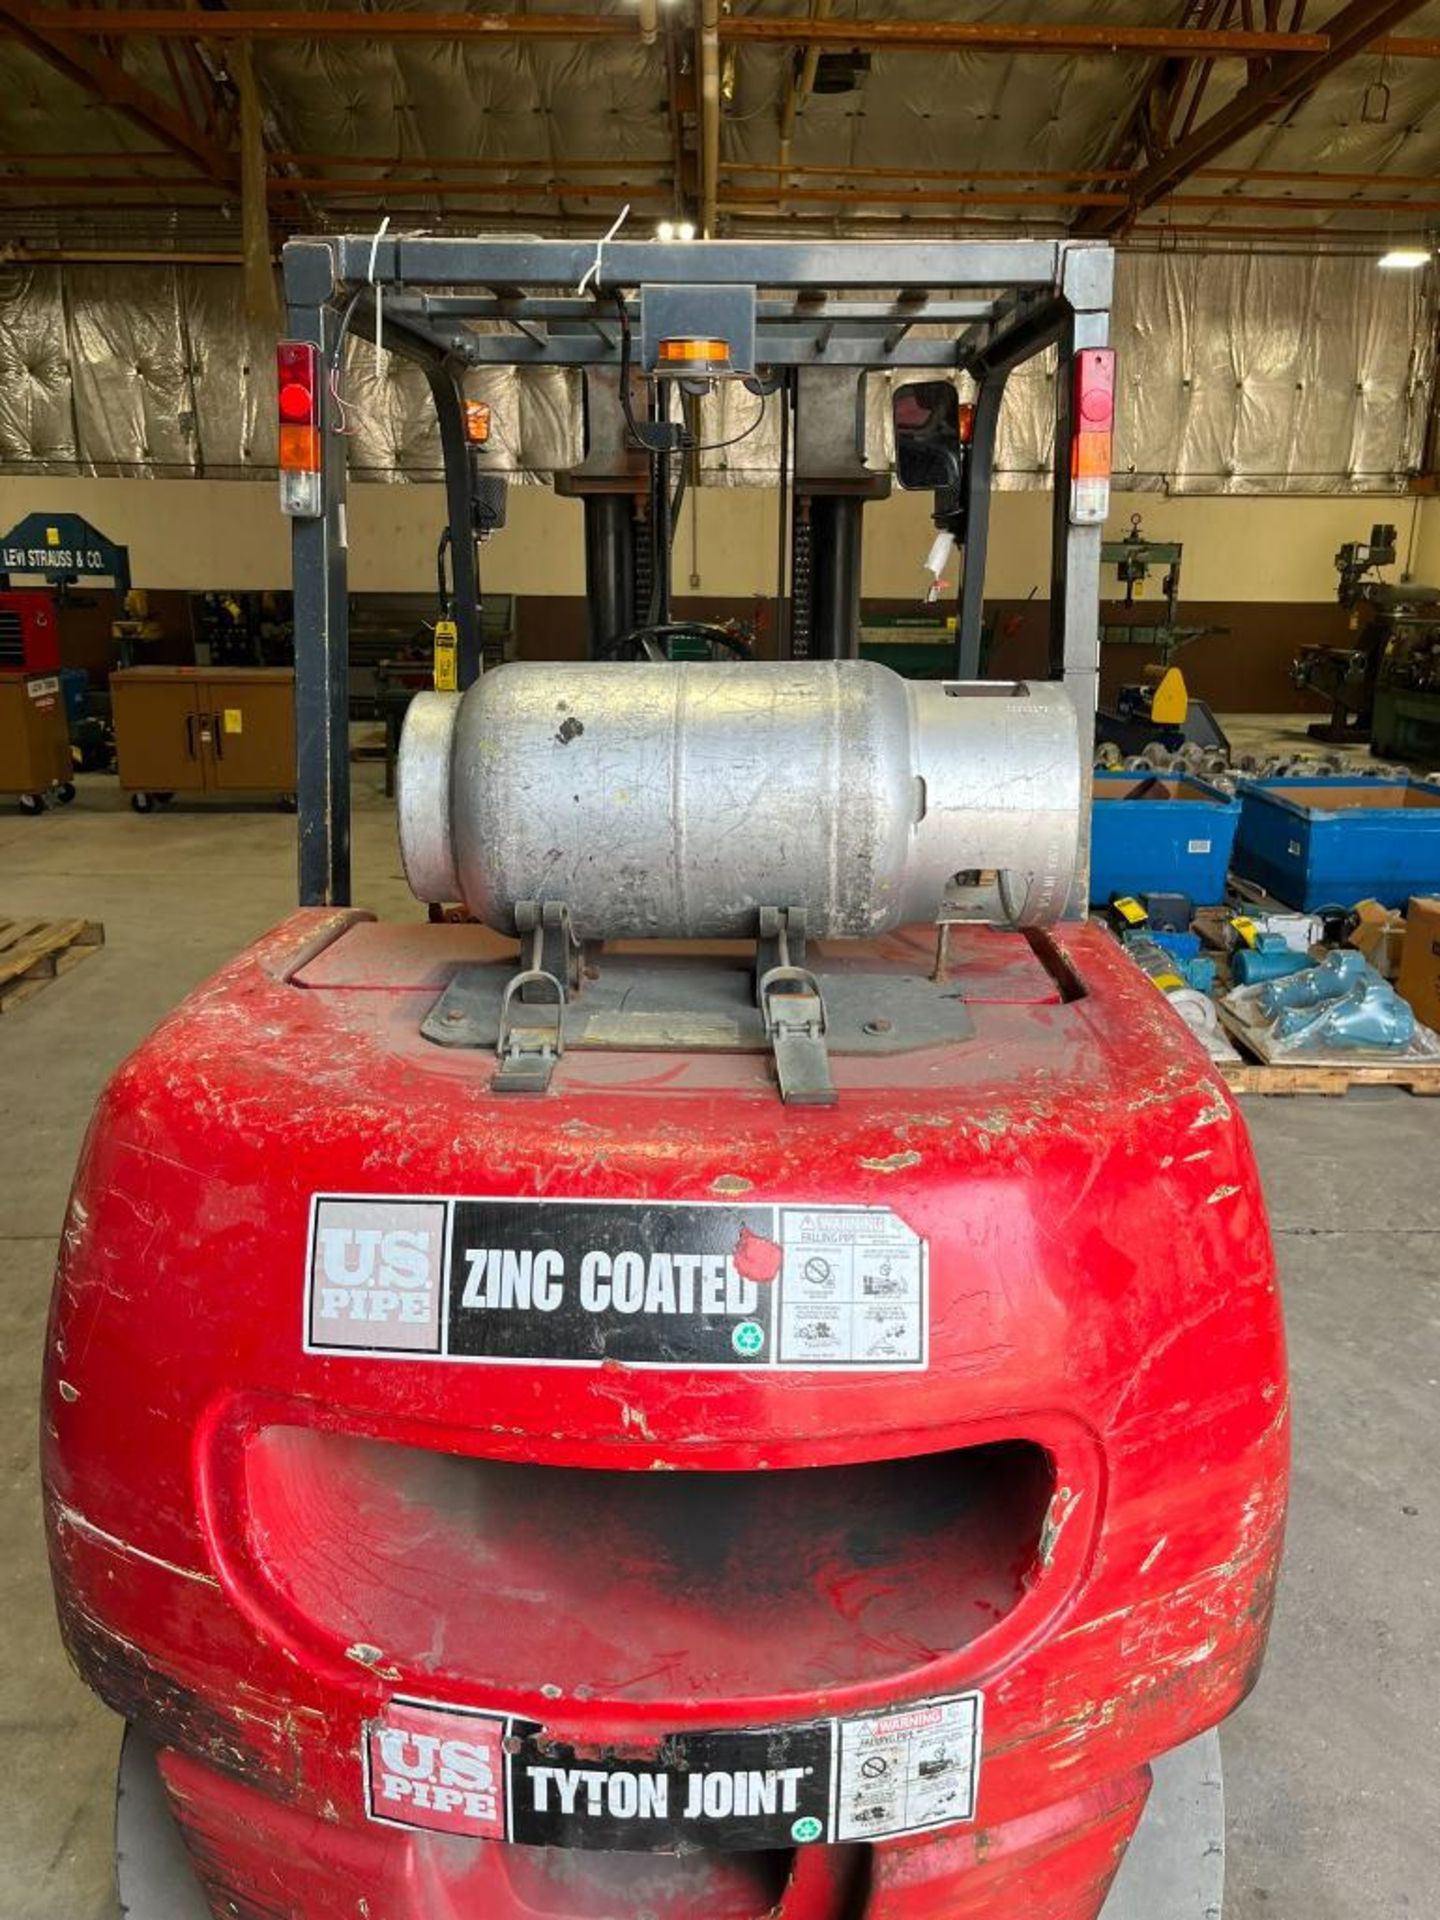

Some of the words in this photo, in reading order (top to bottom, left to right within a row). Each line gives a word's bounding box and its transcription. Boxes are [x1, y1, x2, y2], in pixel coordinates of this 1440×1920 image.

[3, 547, 26, 567] LEVI
[27, 548, 73, 568] STRAUSS
[76, 550, 84, 569] &
[86, 550, 105, 569] CO.
[319, 1228, 434, 1289] U.S.
[461, 1248, 564, 1312] ZINC
[580, 1250, 758, 1314] COATED
[320, 1287, 431, 1323] PIPE
[880, 1710, 939, 1730] WARNING
[376, 1727, 498, 1794] U.S.
[381, 1773, 498, 1820] PIPE
[526, 1765, 668, 1818] TYTON
